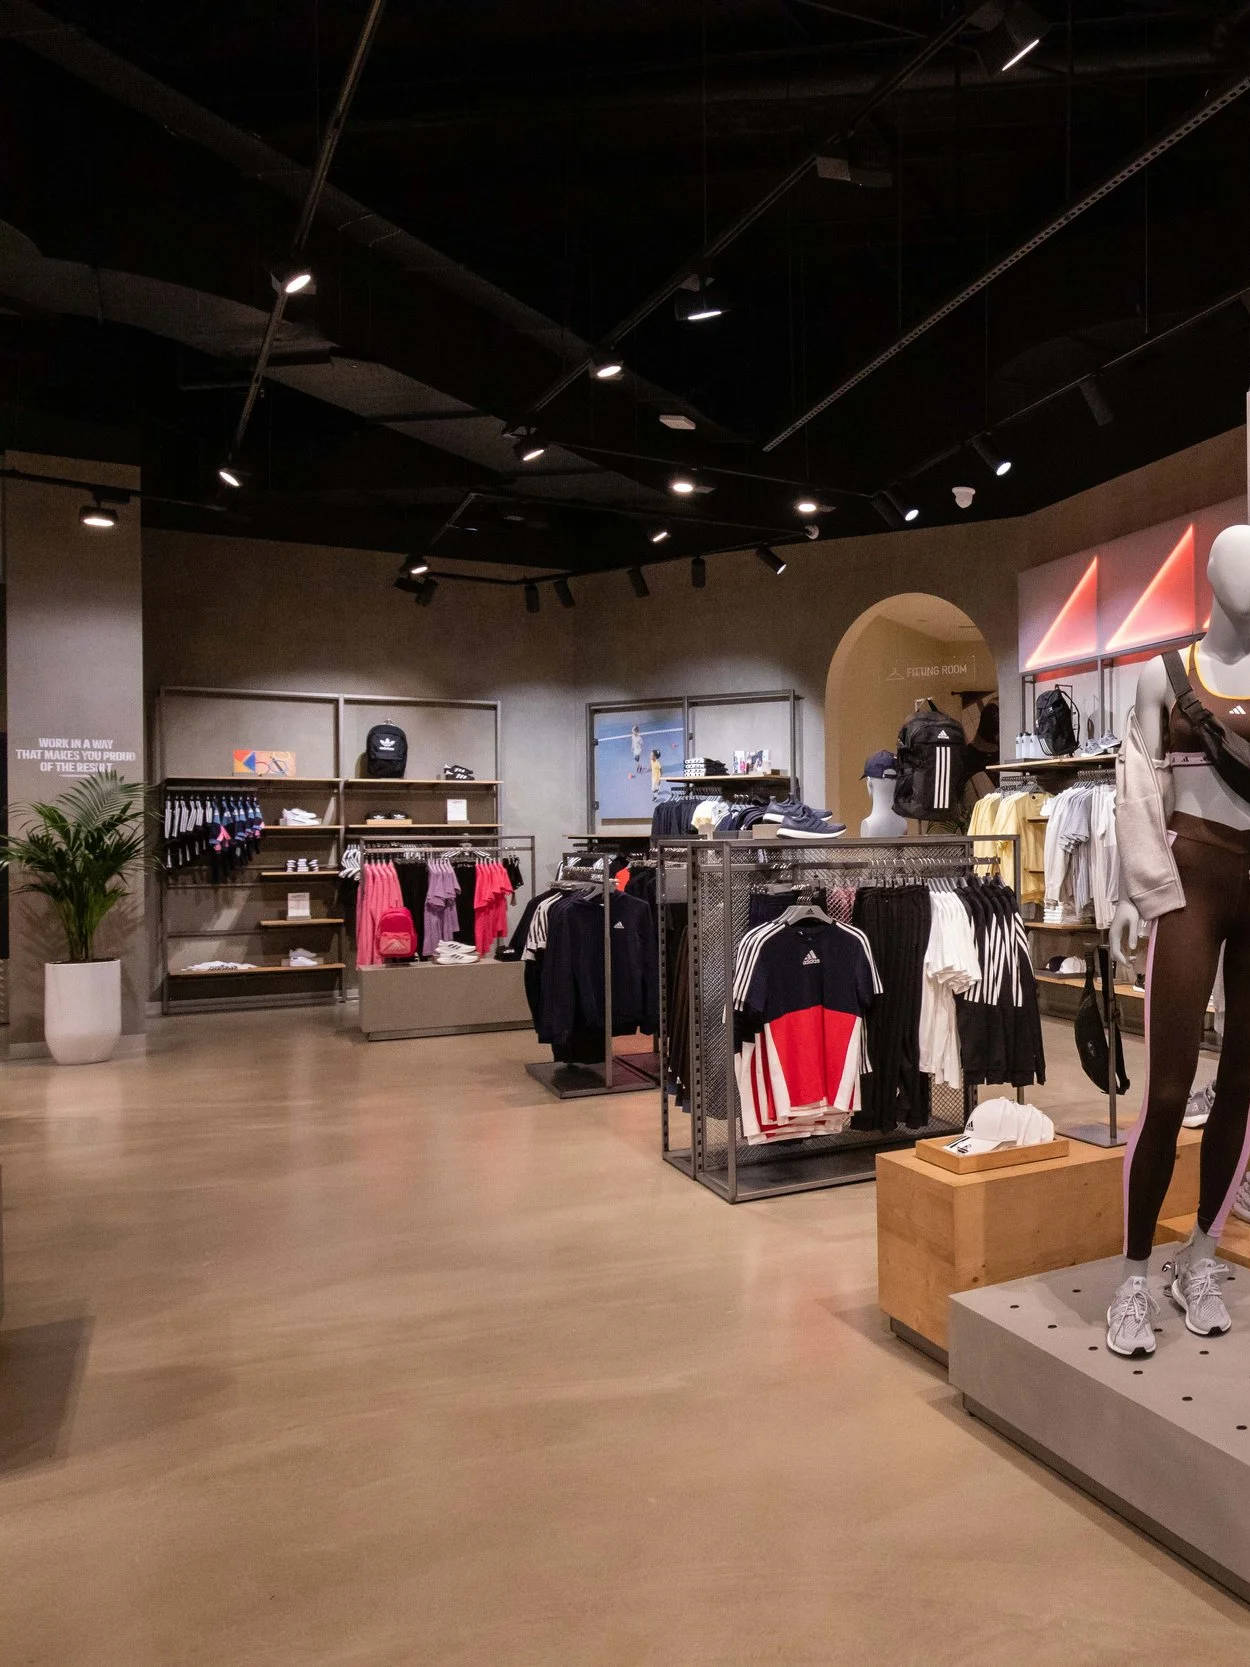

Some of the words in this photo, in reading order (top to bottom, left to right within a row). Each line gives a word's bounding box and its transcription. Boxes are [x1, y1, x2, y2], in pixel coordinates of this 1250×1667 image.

[906, 665, 940, 678] FITTING
[941, 663, 967, 675] ROOM
[38, 737, 69, 748] WORK
[71, 738, 82, 749] IN
[83, 738, 91, 749] A
[92, 738, 114, 749] WAY
[15, 749, 43, 760] THAT
[44, 749, 80, 761] MAKES
[81, 750, 102, 761] YOU
[103, 751, 136, 762] PROUD
[40, 761, 54, 772] OF
[55, 762, 76, 773] THE
[802, 958, 821, 966] adidas
